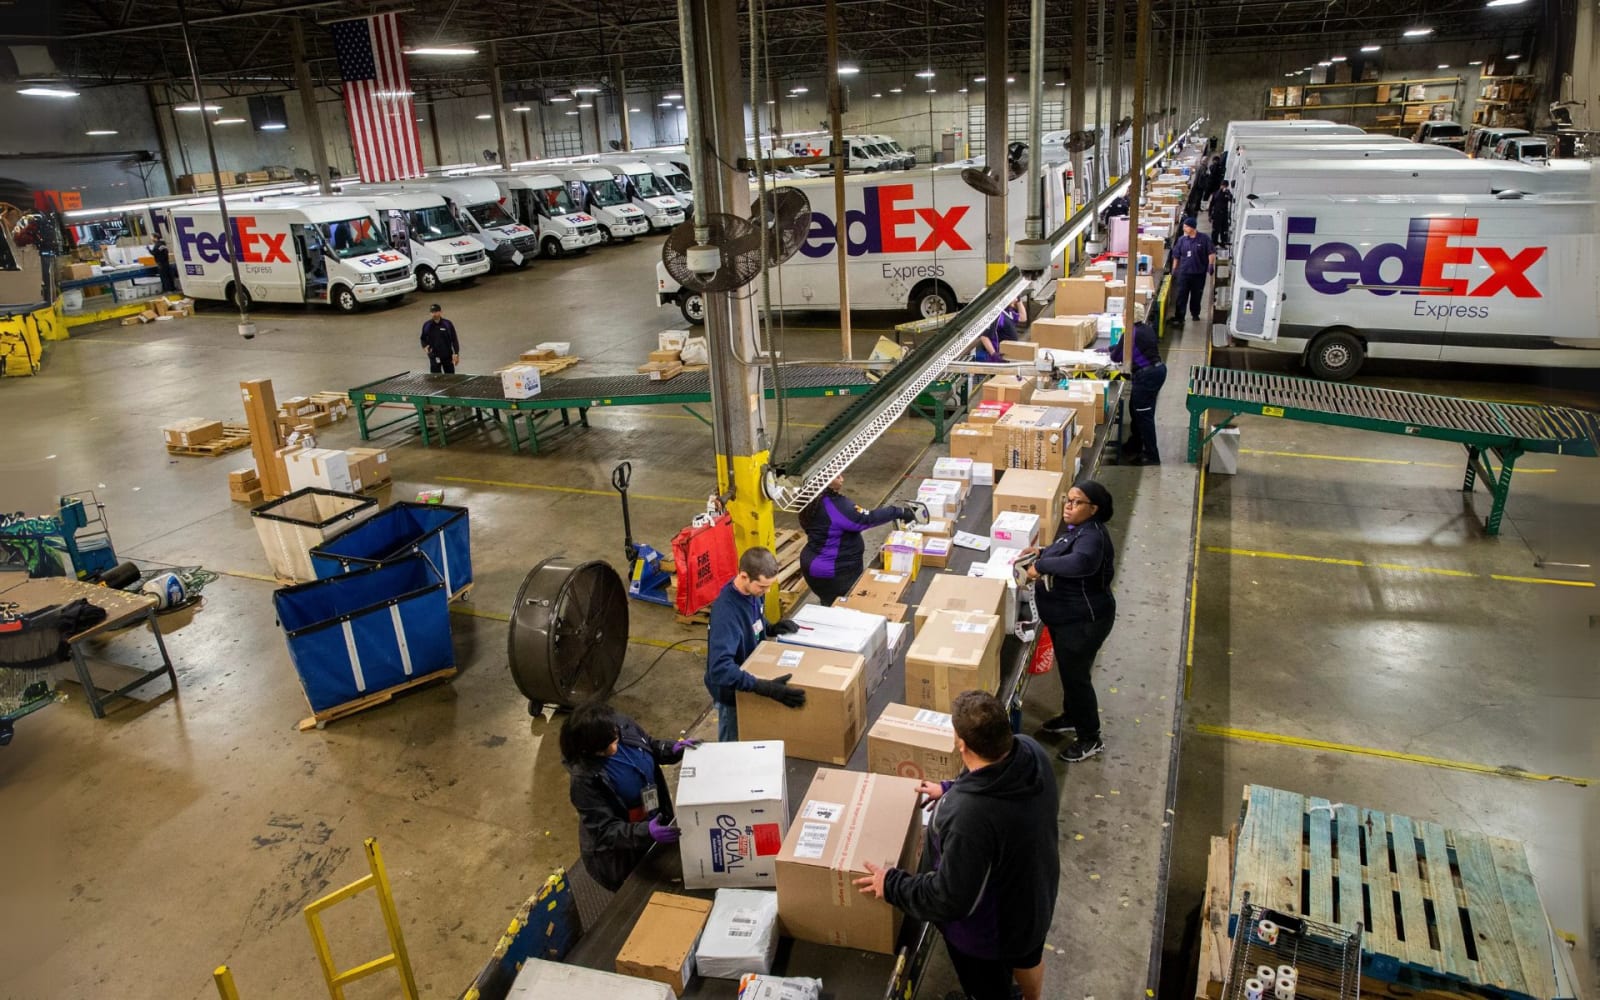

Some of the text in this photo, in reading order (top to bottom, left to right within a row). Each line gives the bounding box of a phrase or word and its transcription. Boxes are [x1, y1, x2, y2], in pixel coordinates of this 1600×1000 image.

[795, 184, 972, 258] edEx
[174, 216, 291, 264] FedEx
[245, 264, 272, 275] Express
[360, 254, 400, 267] FedEx
[882, 263, 944, 280] Express
[1414, 300, 1489, 320] Express
